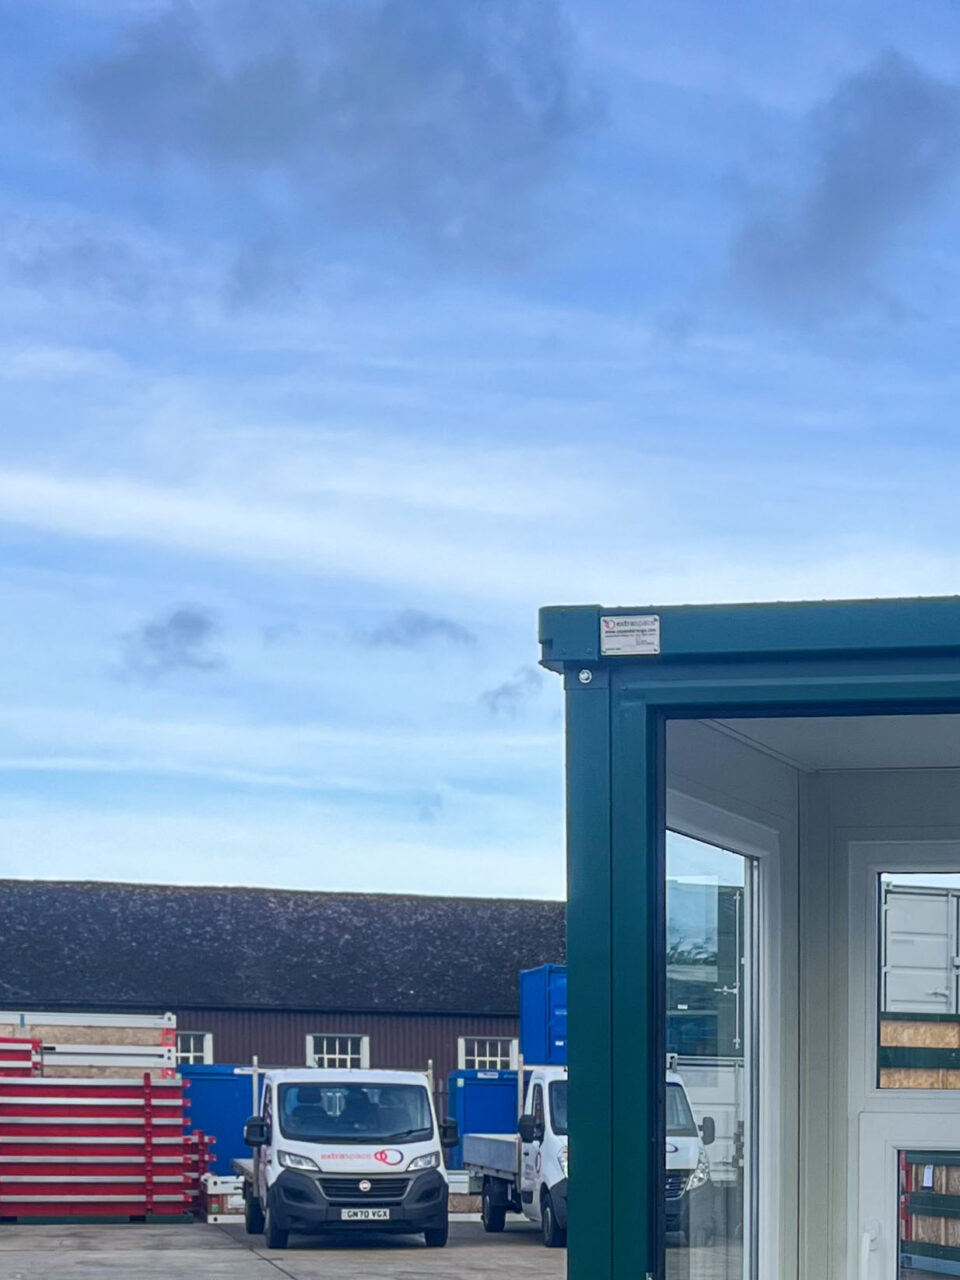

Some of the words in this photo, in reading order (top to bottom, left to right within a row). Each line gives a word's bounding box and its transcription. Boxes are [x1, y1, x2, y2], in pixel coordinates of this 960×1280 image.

[320, 1152, 372, 1160] extraspace
[347, 1210, 370, 1218] GN70
[371, 1210, 388, 1218] VGX
